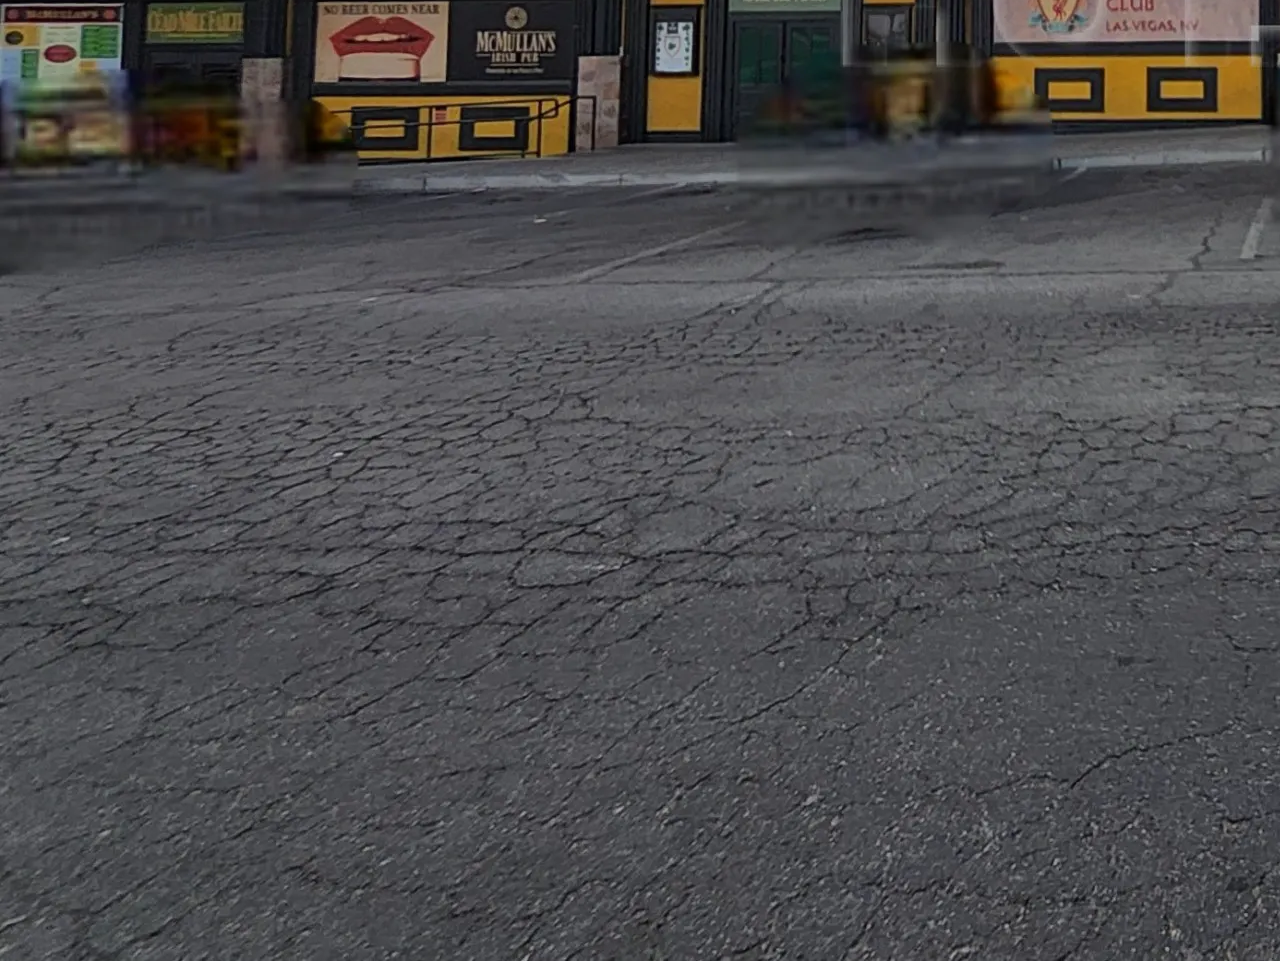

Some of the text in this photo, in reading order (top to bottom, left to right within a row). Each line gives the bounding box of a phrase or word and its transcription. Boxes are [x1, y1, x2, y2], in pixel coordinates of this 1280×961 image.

[323, 4, 440, 15] NO BEER COMES NEAR
[1106, 20, 1129, 32] LAS
[521, 52, 539, 62] PUB
